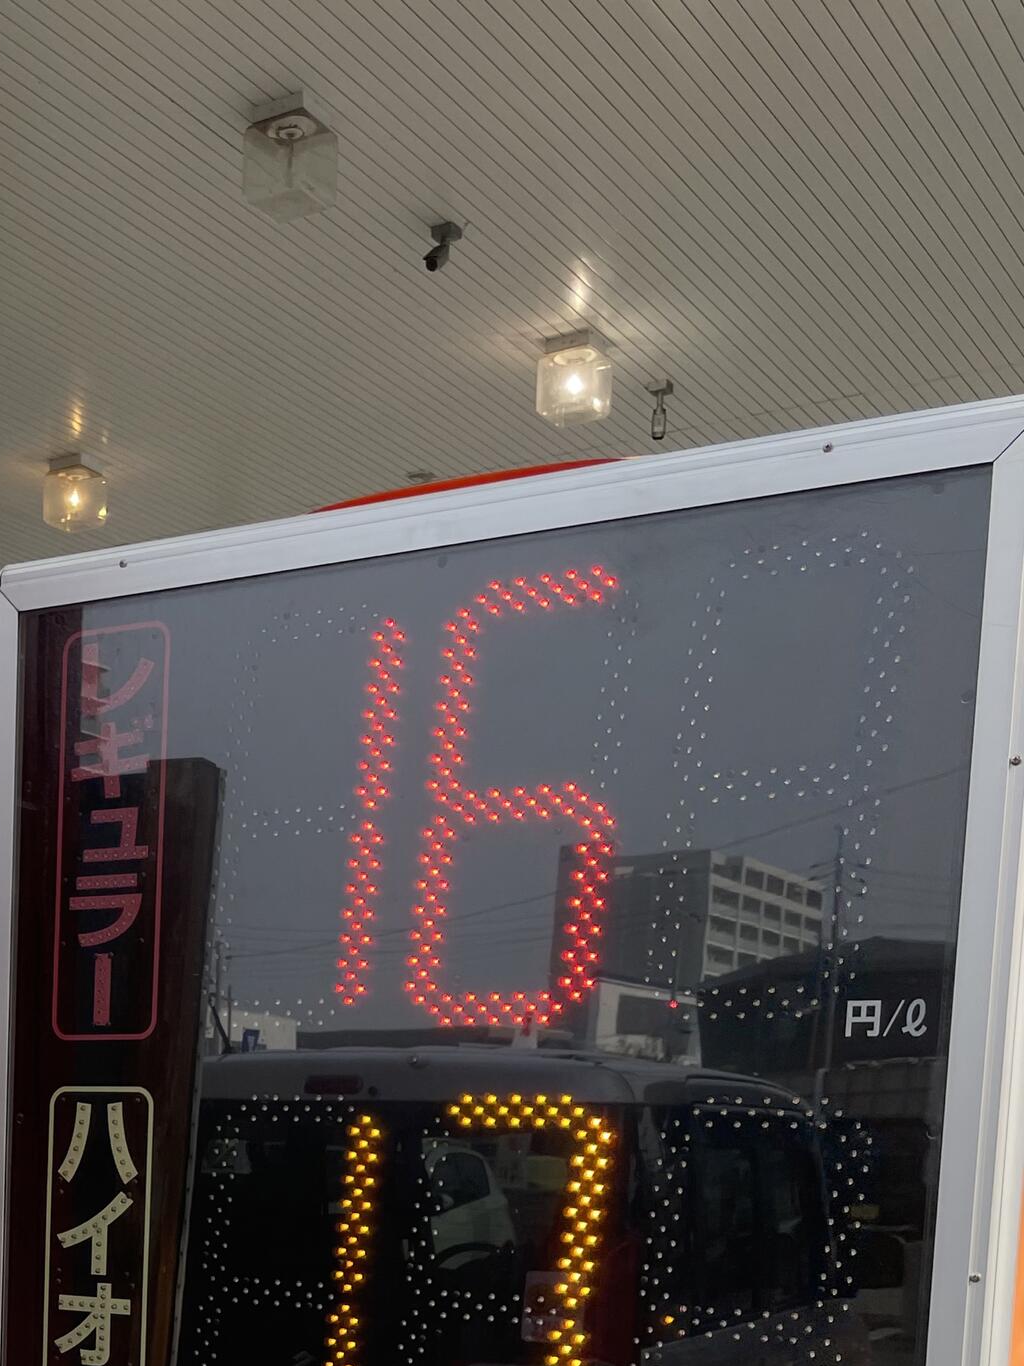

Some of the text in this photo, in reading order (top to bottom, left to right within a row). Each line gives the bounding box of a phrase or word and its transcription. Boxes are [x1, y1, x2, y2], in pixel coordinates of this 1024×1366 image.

[69, 642, 155, 1027] レギュラー
